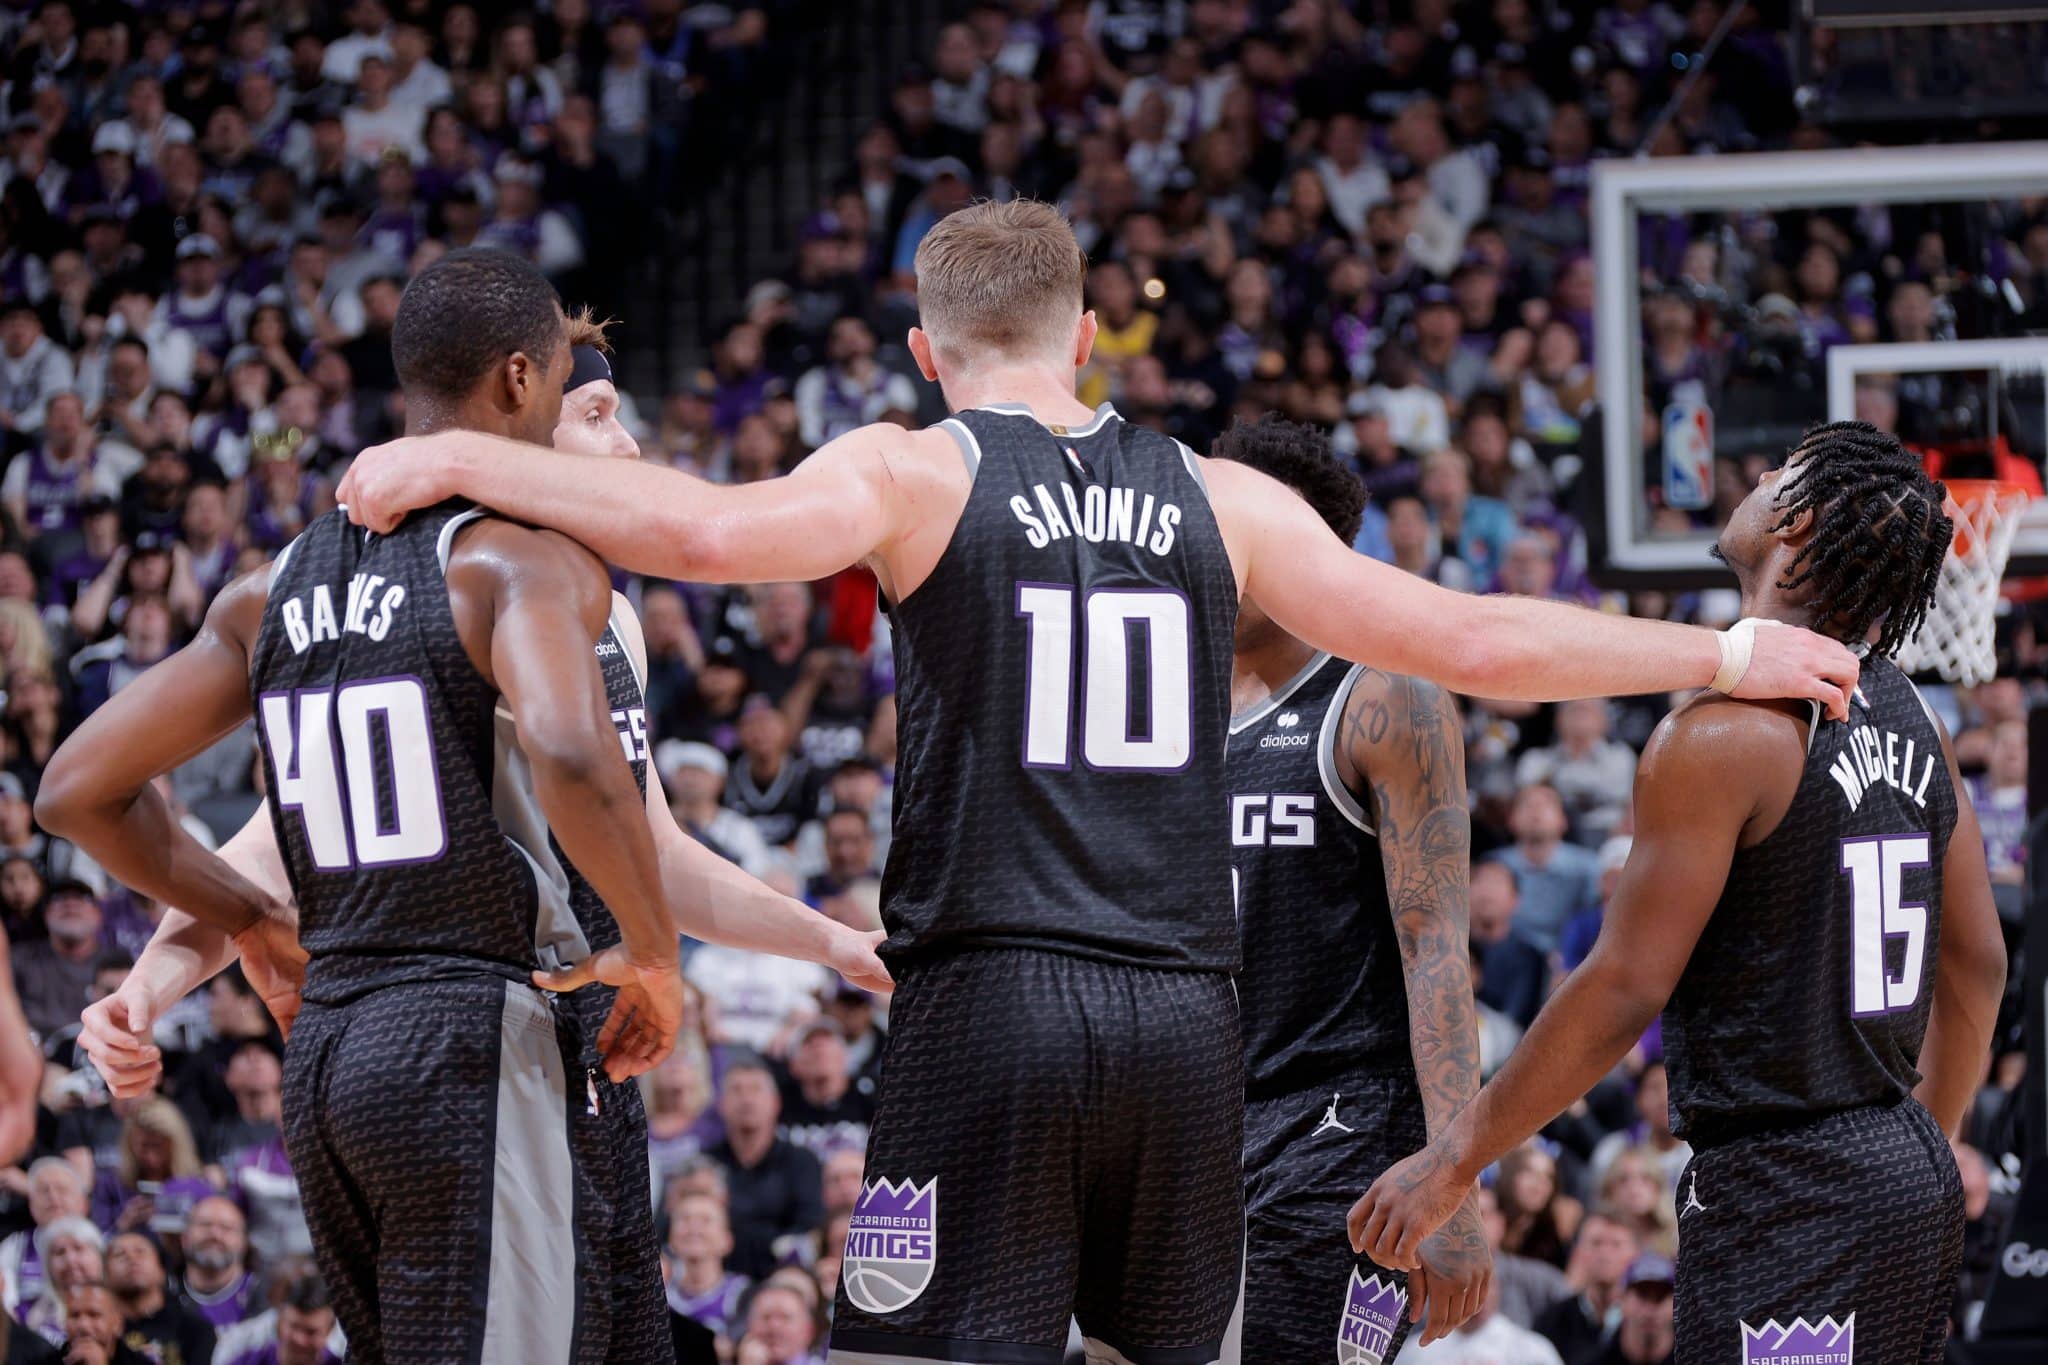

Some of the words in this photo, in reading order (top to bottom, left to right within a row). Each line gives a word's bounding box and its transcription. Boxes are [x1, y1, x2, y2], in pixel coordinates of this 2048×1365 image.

[1015, 580, 1195, 775] 10
[259, 673, 448, 873] 40
[1260, 733, 1309, 749] dialpad
[1840, 832, 1931, 1019] 15
[845, 1231, 932, 1260] KINGS
[850, 1215, 928, 1228] SACRAMENTO
